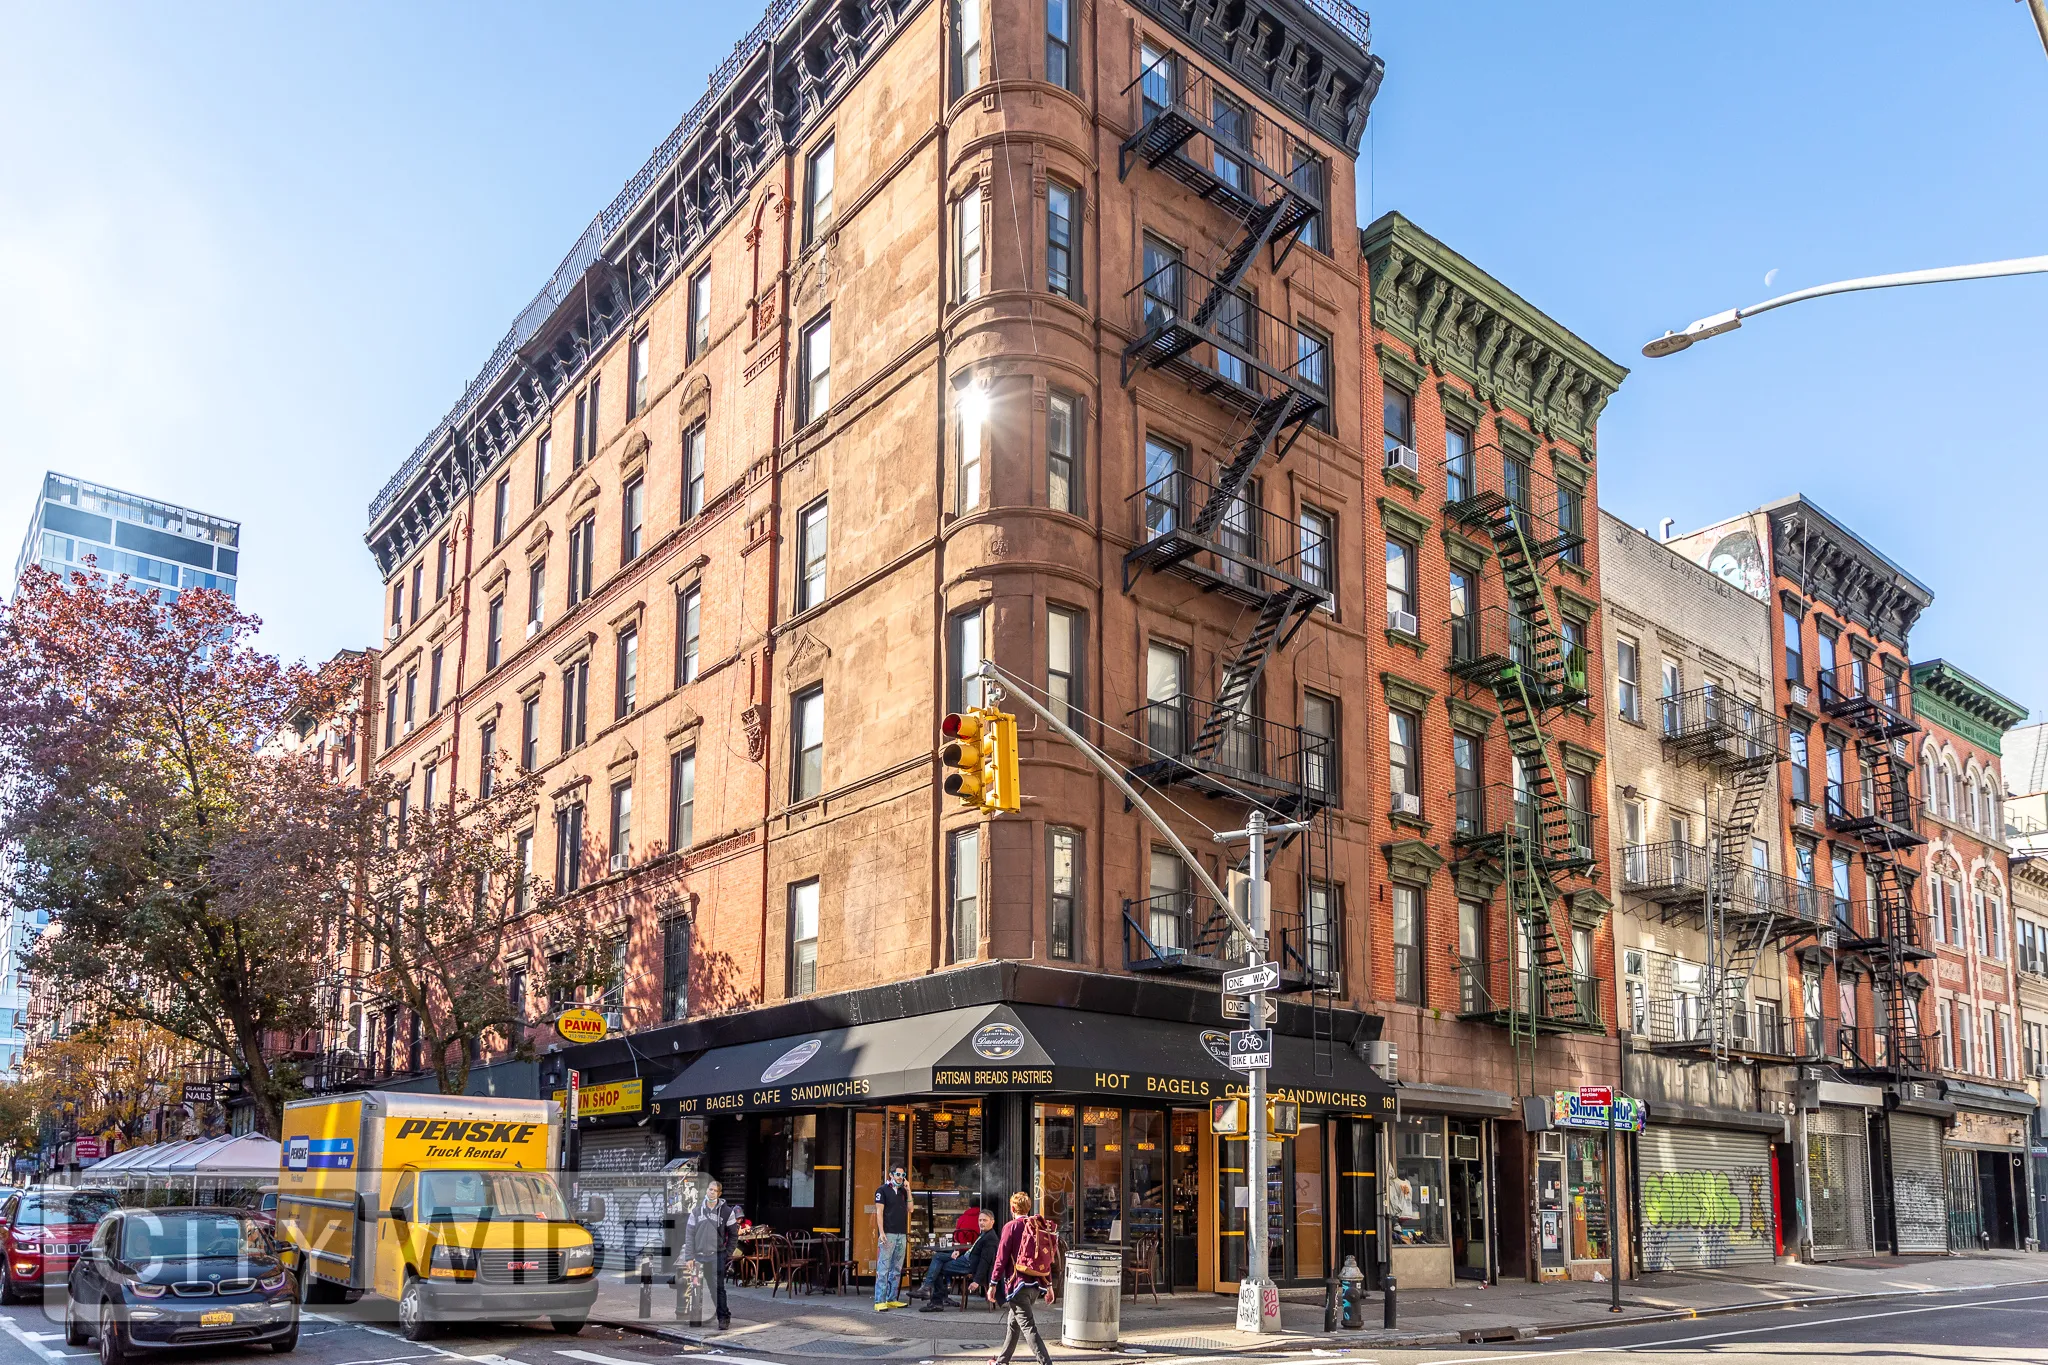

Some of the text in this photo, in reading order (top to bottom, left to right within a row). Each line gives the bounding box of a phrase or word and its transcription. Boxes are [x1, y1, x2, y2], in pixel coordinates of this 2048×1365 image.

[1228, 971, 1271, 989] ONE WAY
[1227, 1001, 1245, 1012] ONE
[564, 1019, 601, 1032] PAWN
[976, 1036, 1022, 1045] Davidovich
[1232, 1054, 1269, 1066] BIKE LANE
[935, 1070, 1053, 1085] ARTISAN BREADS PASTRIES
[185, 1092, 212, 1101] NAILS
[679, 1078, 870, 1113] HOT BAGELS CAFE SANDWICHES
[1095, 1072, 1131, 1089] HOT
[1147, 1076, 1210, 1096] BAGELS
[1277, 1087, 1368, 1108] SANDWICHES
[1382, 1096, 1396, 1110] 161
[592, 1090, 620, 1108] SHOP
[651, 1103, 661, 1115] 79
[396, 1119, 538, 1144] PENSKE
[290, 1147, 308, 1160] PENSKE
[425, 1145, 508, 1159] Truck Rental
[875, 1192, 882, 1201] 3
[507, 1261, 540, 1270] GMC
